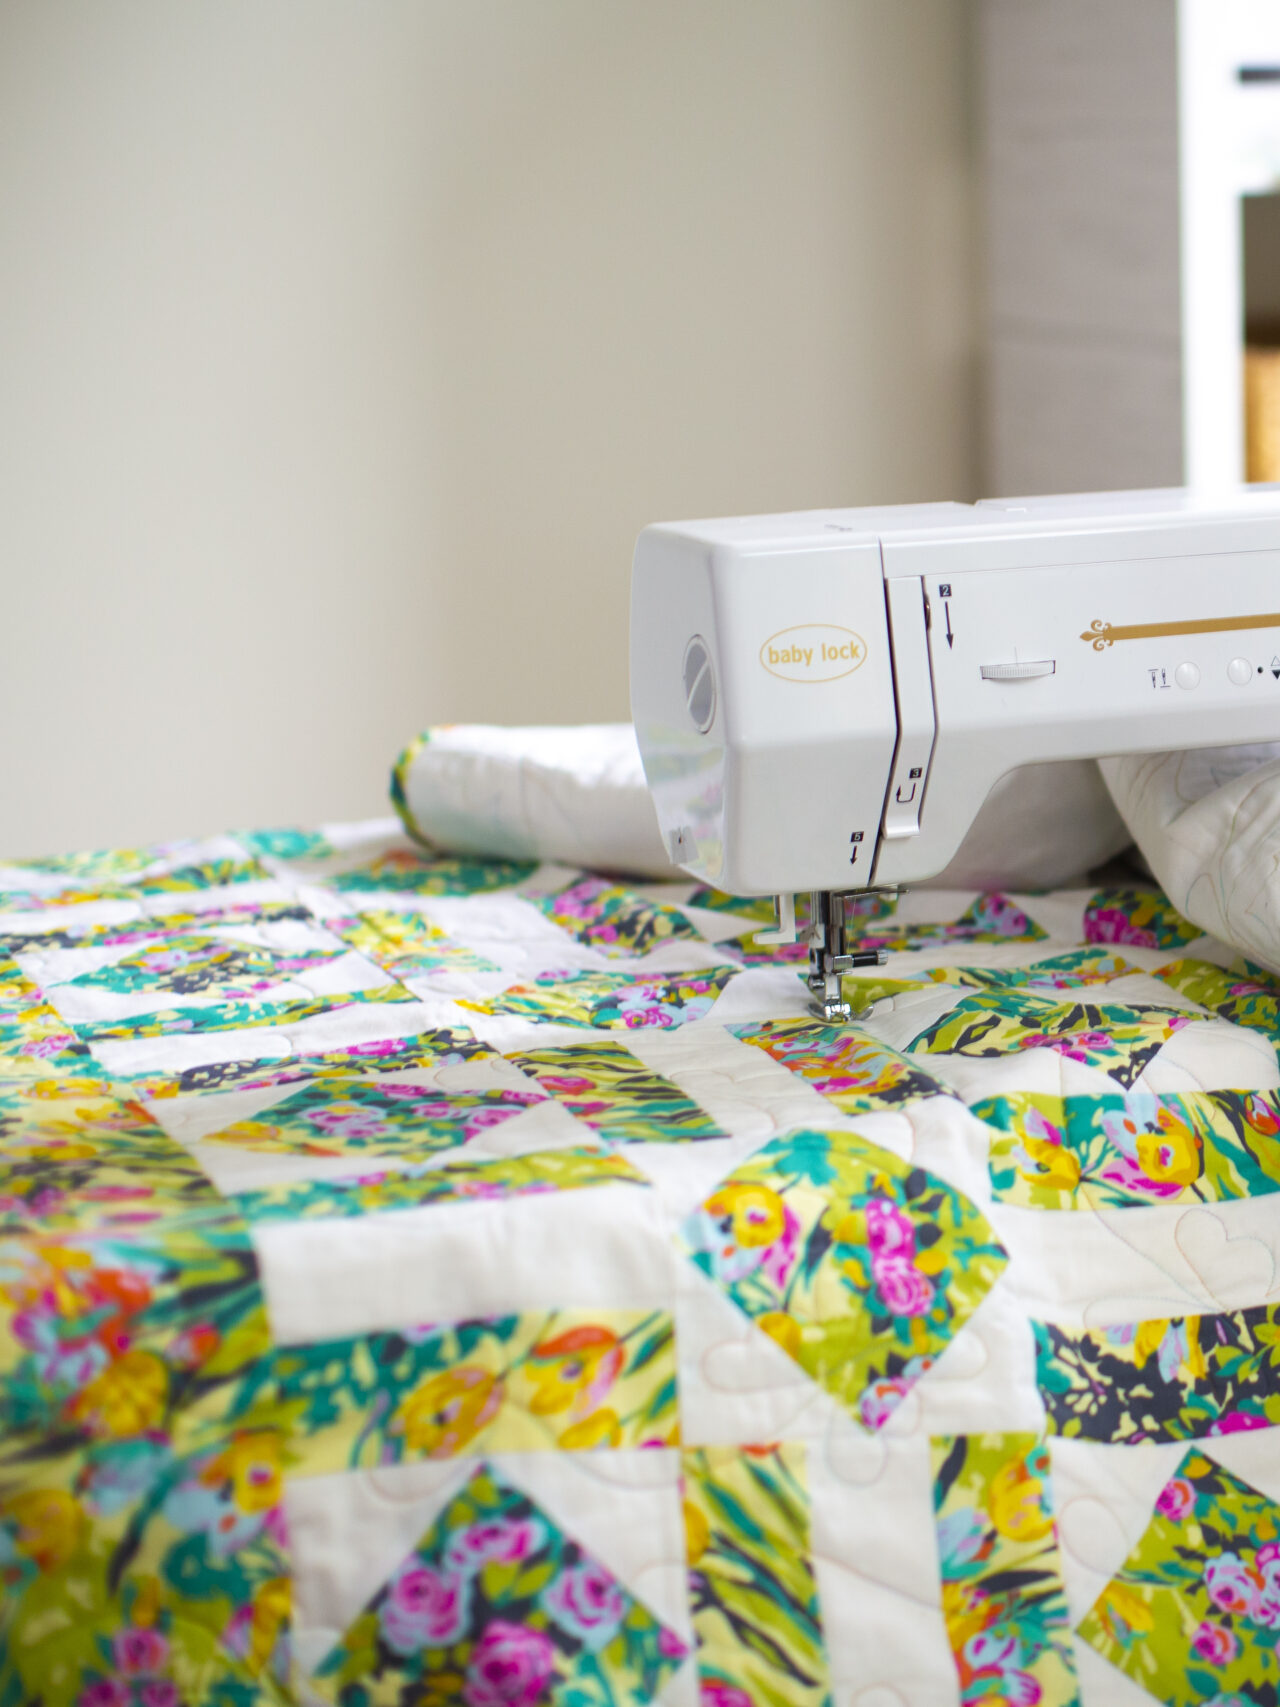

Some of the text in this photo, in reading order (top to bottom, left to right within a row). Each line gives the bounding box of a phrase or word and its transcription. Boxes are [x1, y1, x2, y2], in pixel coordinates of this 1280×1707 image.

[941, 584, 951, 597] 2
[768, 640, 860, 667] baby lock
